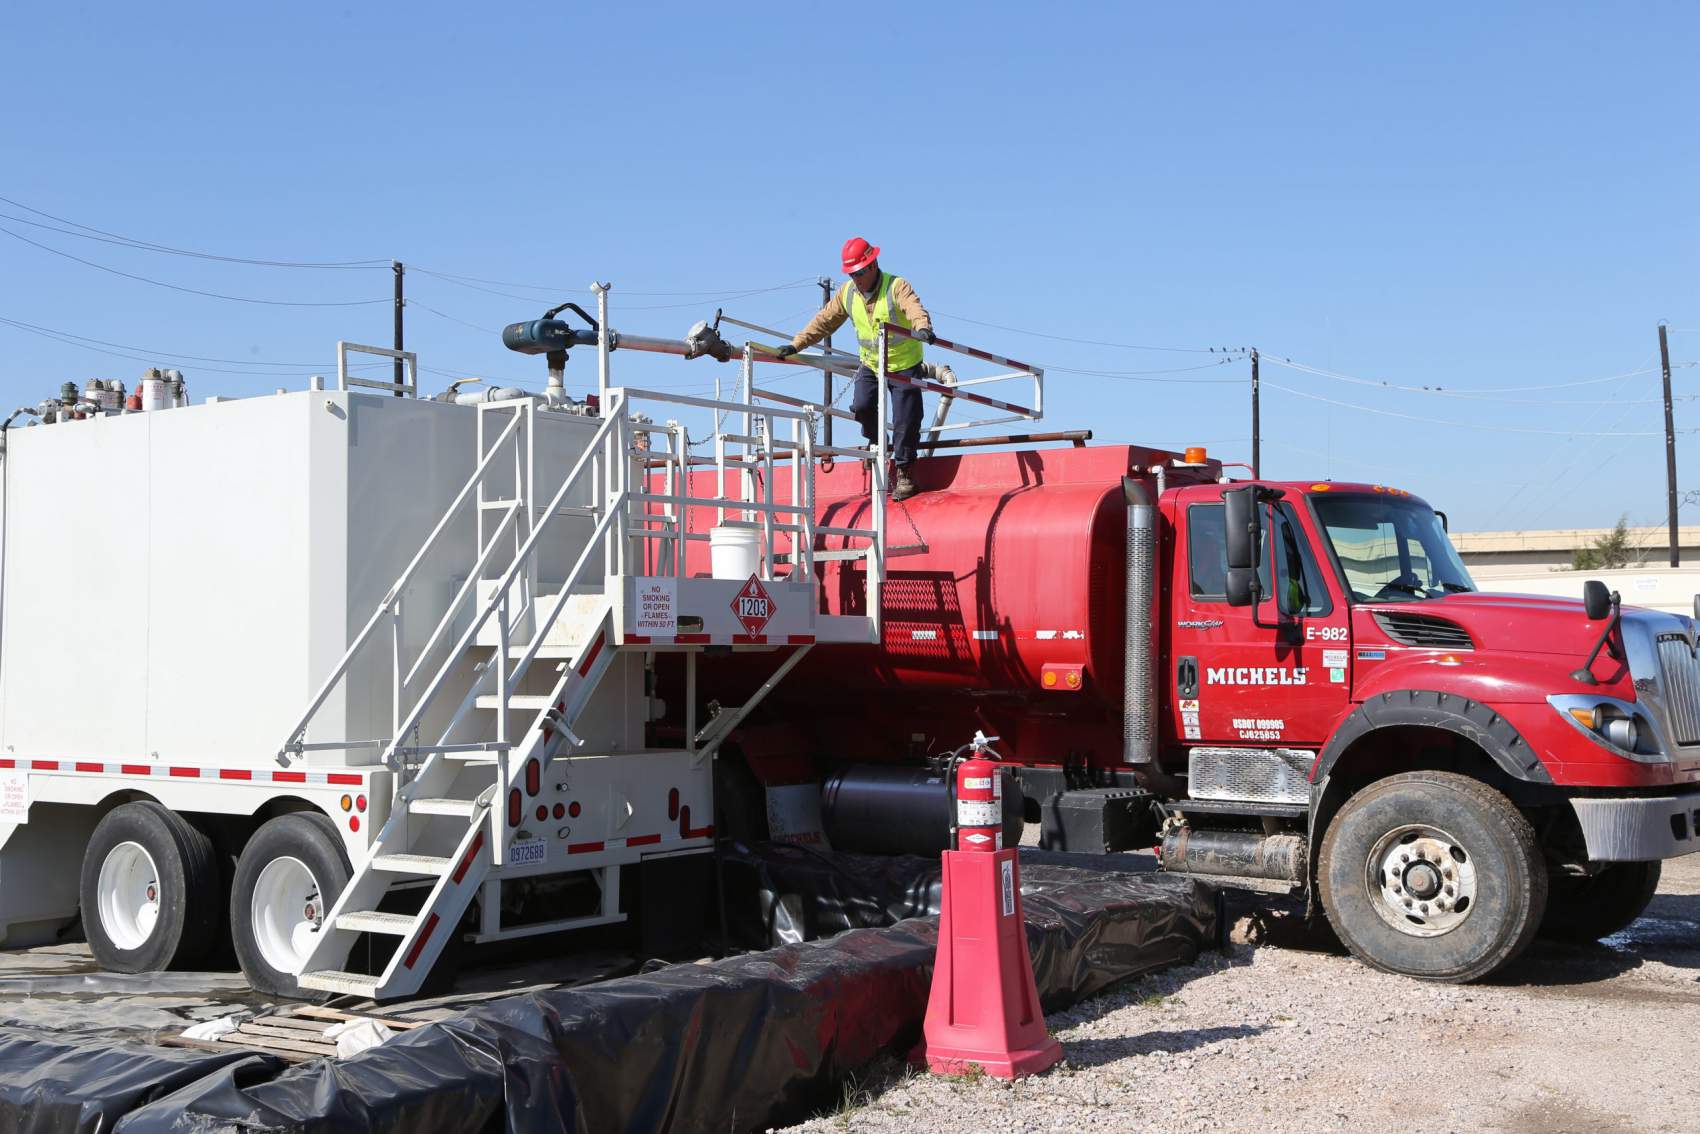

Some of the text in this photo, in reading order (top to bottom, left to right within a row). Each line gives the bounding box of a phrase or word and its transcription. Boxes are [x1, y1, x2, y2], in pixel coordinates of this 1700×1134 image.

[654, 603, 670, 611] OPEN
[741, 599, 766, 616] 1203
[751, 626, 756, 635] 3
[1306, 627, 1348, 640] E-982
[1207, 667, 1306, 685] MICHELS
